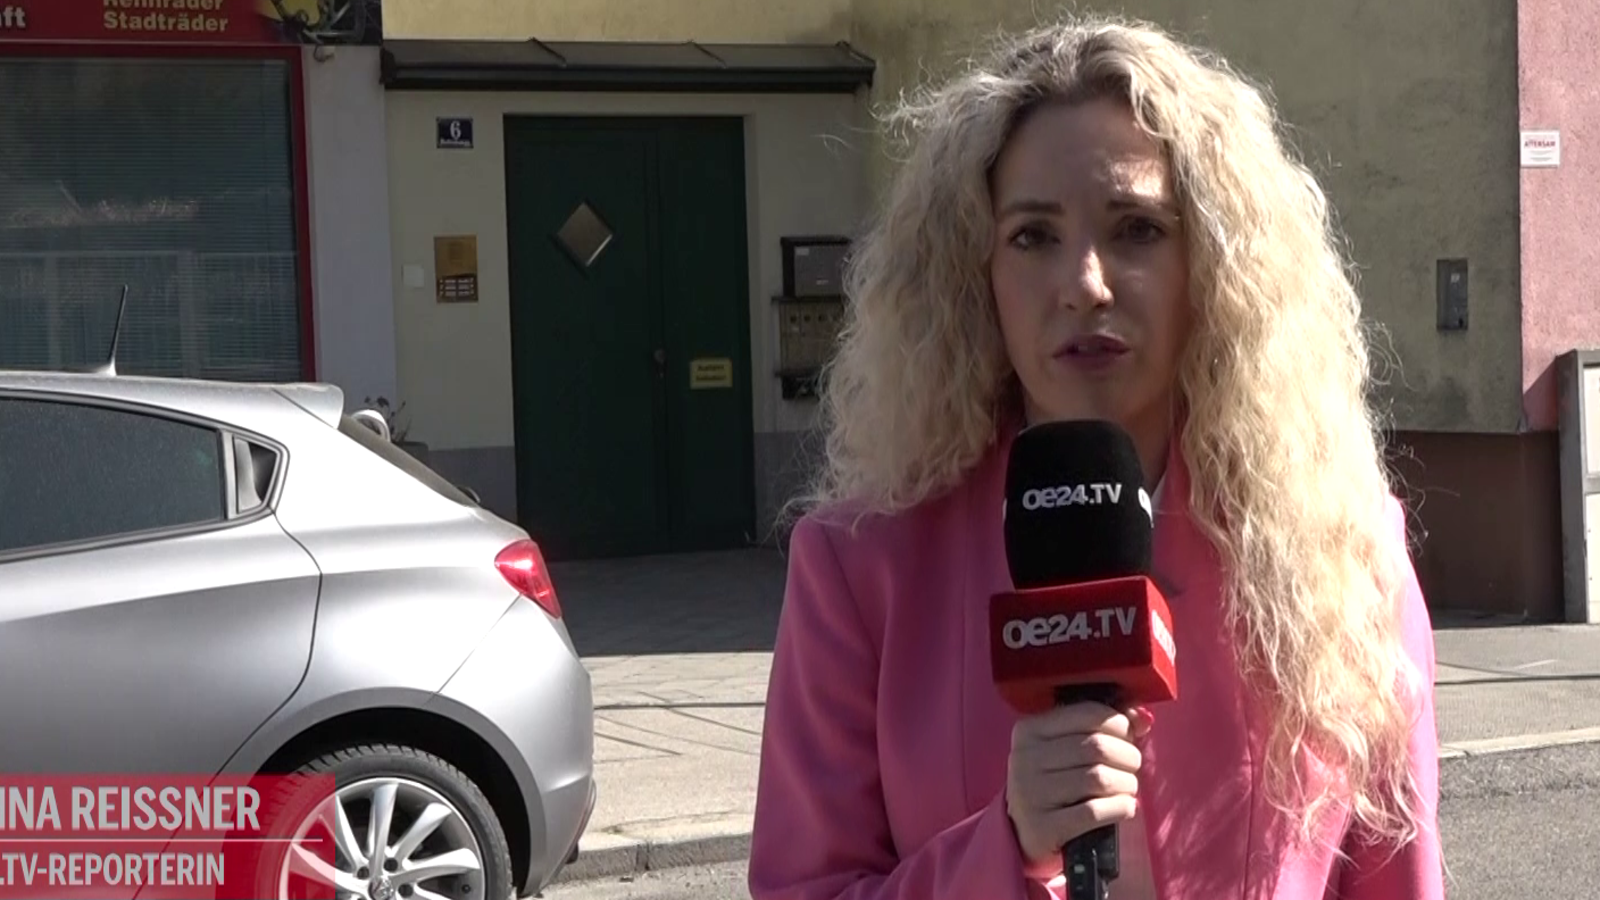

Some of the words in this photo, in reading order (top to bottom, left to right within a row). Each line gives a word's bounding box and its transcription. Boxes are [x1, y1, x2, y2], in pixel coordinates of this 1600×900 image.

[0, 6, 26, 28] ft
[103, 11, 228, 32] Stadträder
[450, 120, 462, 140] 6
[1022, 483, 1122, 510] oe24.TV
[1003, 607, 1137, 649] oe24.TV
